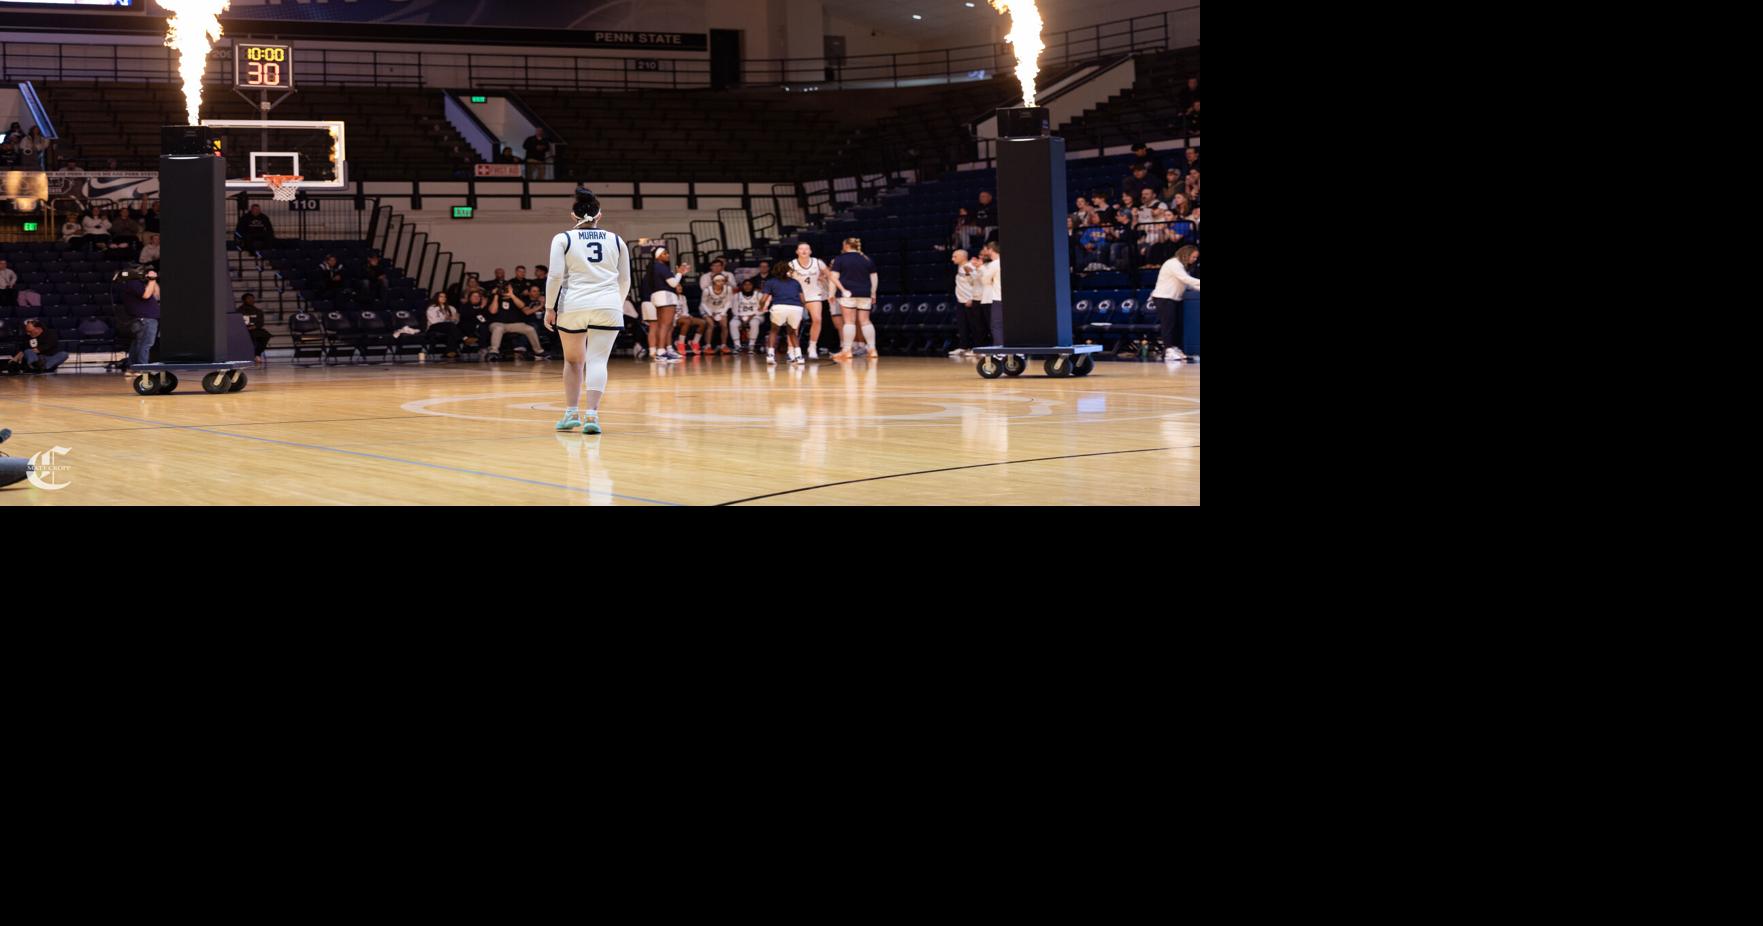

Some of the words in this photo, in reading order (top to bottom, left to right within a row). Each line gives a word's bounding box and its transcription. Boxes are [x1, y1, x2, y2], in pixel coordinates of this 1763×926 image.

[594, 32, 635, 42] PENN
[638, 33, 682, 45] STATE
[247, 47, 285, 61] 10:00
[637, 61, 656, 70] 210
[248, 61, 280, 85] 30
[293, 200, 317, 209] 110
[578, 231, 607, 240] MURRAY
[586, 242, 603, 263] 3
[804, 277, 811, 285] 4
